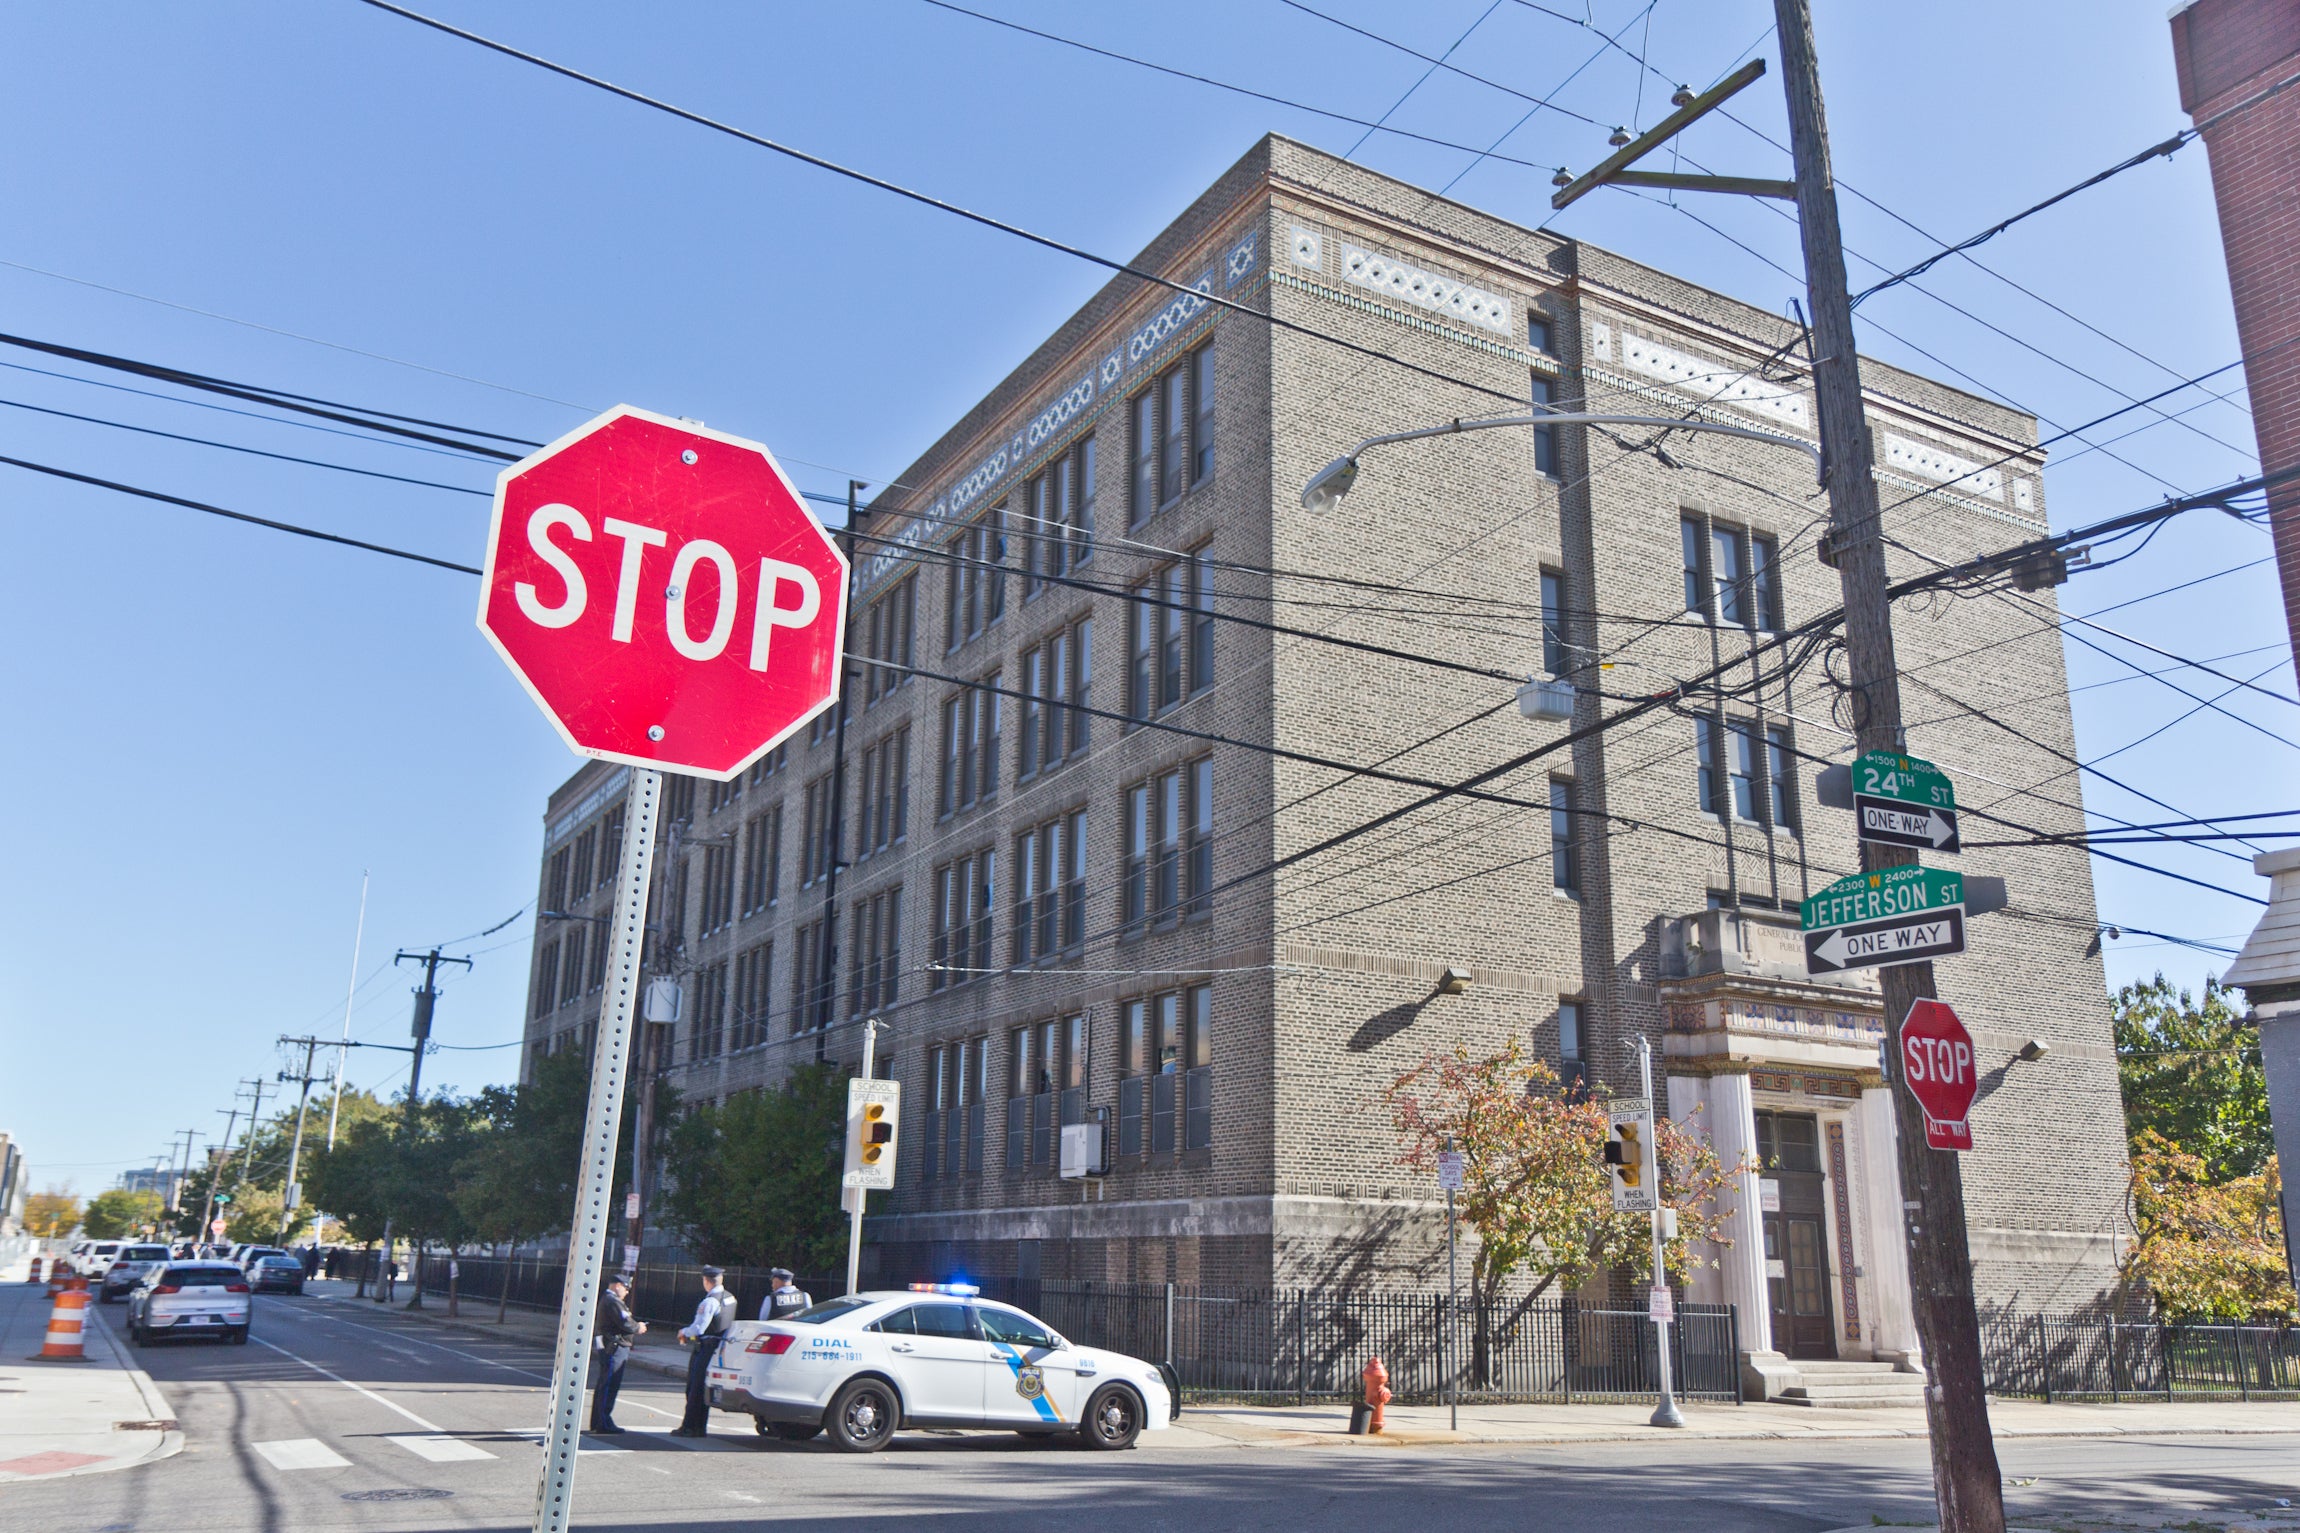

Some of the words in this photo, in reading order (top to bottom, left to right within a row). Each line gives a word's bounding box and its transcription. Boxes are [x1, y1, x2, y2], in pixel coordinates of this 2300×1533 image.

[514, 503, 821, 673] STOP
[1874, 755, 1896, 767] 1500
[1899, 757, 1909, 771] N
[1910, 762, 1931, 774] 1400
[1930, 785, 1949, 804] ST
[1867, 809, 1897, 830] ONE
[1901, 815, 1929, 834] WAY
[1838, 879, 1865, 893] 2300
[1868, 873, 1881, 888] W
[1885, 870, 1914, 883] 2400
[1806, 881, 1928, 928] JEFFERSON
[1940, 883, 1958, 904] ST
[1757, 926, 1791, 940] GENERAL
[1847, 932, 1888, 955] ONE
[1895, 924, 1941, 947] WAY
[1780, 941, 1805, 954] PUBLIC
[1907, 1035, 1970, 1085] STOP
[857, 1081, 892, 1092] SCHOOL
[854, 1092, 876, 1102] SPEED
[877, 1094, 895, 1103] LIMIT
[1614, 1101, 1645, 1111] SCHOOL
[1612, 1113, 1631, 1123] SPEED
[1632, 1111, 1647, 1121] LIMIT
[1929, 1122, 1946, 1135] ALL
[1951, 1123, 1967, 1137] WAY
[858, 1167, 881, 1176] WHEN
[849, 1175, 888, 1185] FLASHING
[1623, 1190, 1644, 1199] WHEN
[1617, 1199, 1652, 1209] FLASHING
[812, 1338, 852, 1348] DIAL
